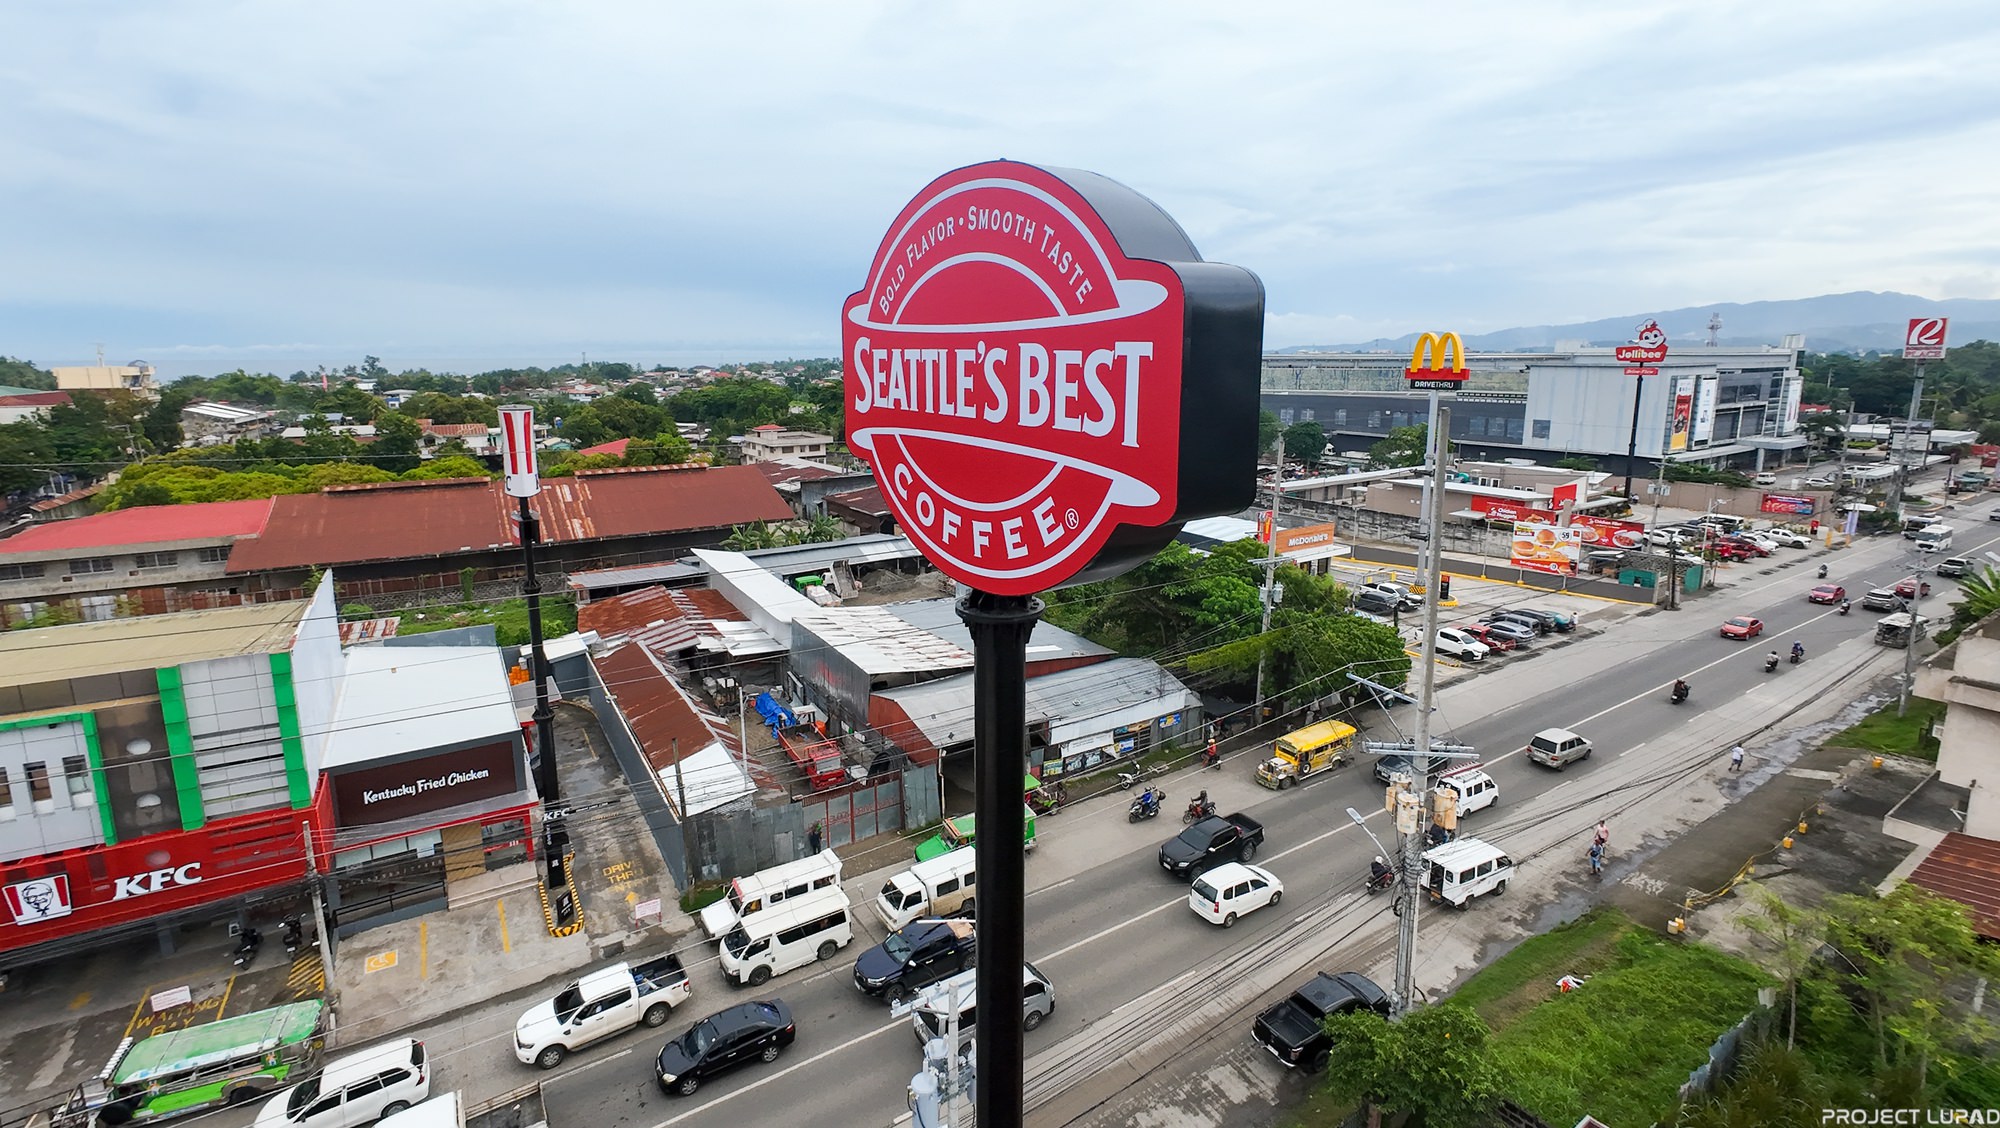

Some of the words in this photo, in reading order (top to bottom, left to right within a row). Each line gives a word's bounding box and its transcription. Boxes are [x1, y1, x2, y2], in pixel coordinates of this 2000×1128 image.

[879, 268, 906, 316] BOLD
[906, 216, 956, 269] FLAVOR
[967, 205, 1037, 242] SMOOTH
[1040, 223, 1094, 305] TASTE
[1618, 348, 1663, 359] Jollibee
[853, 336, 1009, 424] SEATTLE'S
[1018, 341, 1154, 448] BEST
[894, 462, 1066, 561] COFFEE
[1288, 533, 1329, 547] McDonald's
[363, 784, 416, 804] Kentucky
[416, 777, 446, 793] Fried
[447, 769, 490, 786] Chicken
[543, 807, 571, 822] KFC
[112, 862, 202, 901] KFC
